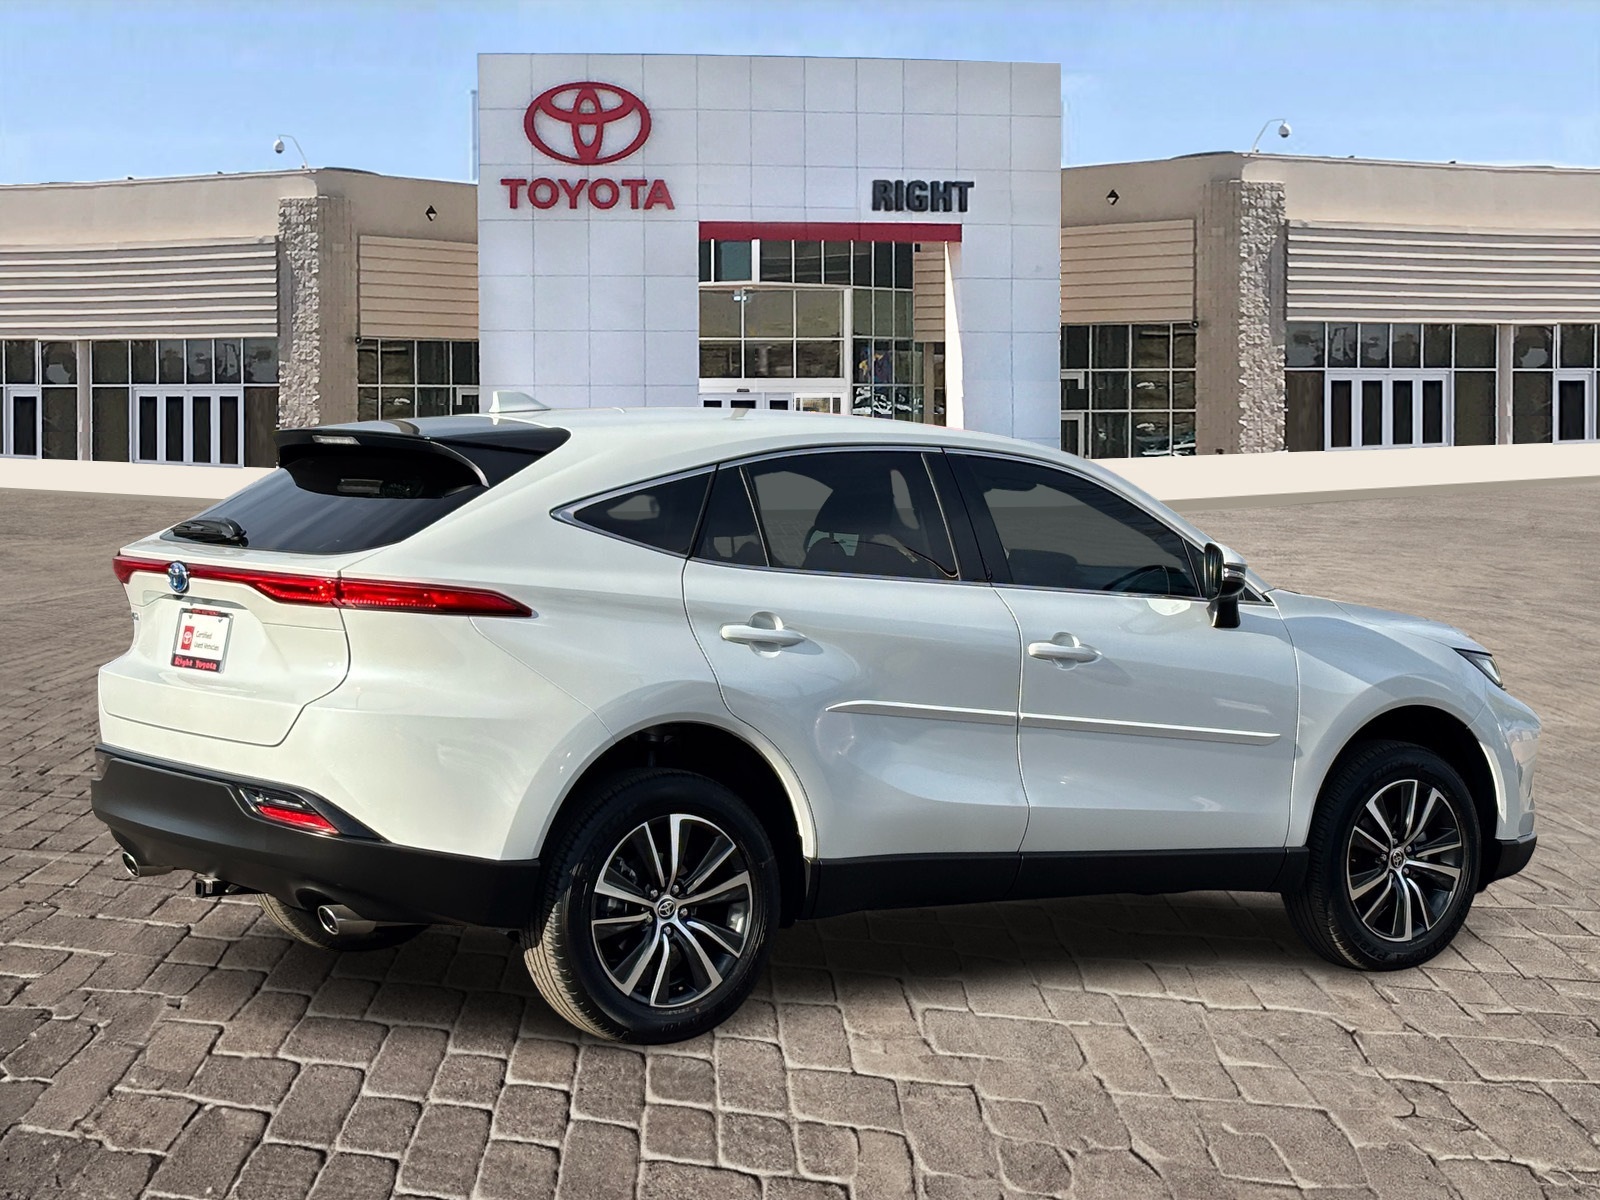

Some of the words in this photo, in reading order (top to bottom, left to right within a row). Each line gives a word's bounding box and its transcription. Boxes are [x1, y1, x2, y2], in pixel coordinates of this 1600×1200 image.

[500, 178, 675, 211] TOYOTA
[871, 179, 975, 213] RIGHT
[196, 631, 213, 639] Certified
[175, 656, 193, 667] Right
[196, 660, 217, 670] Toyota
